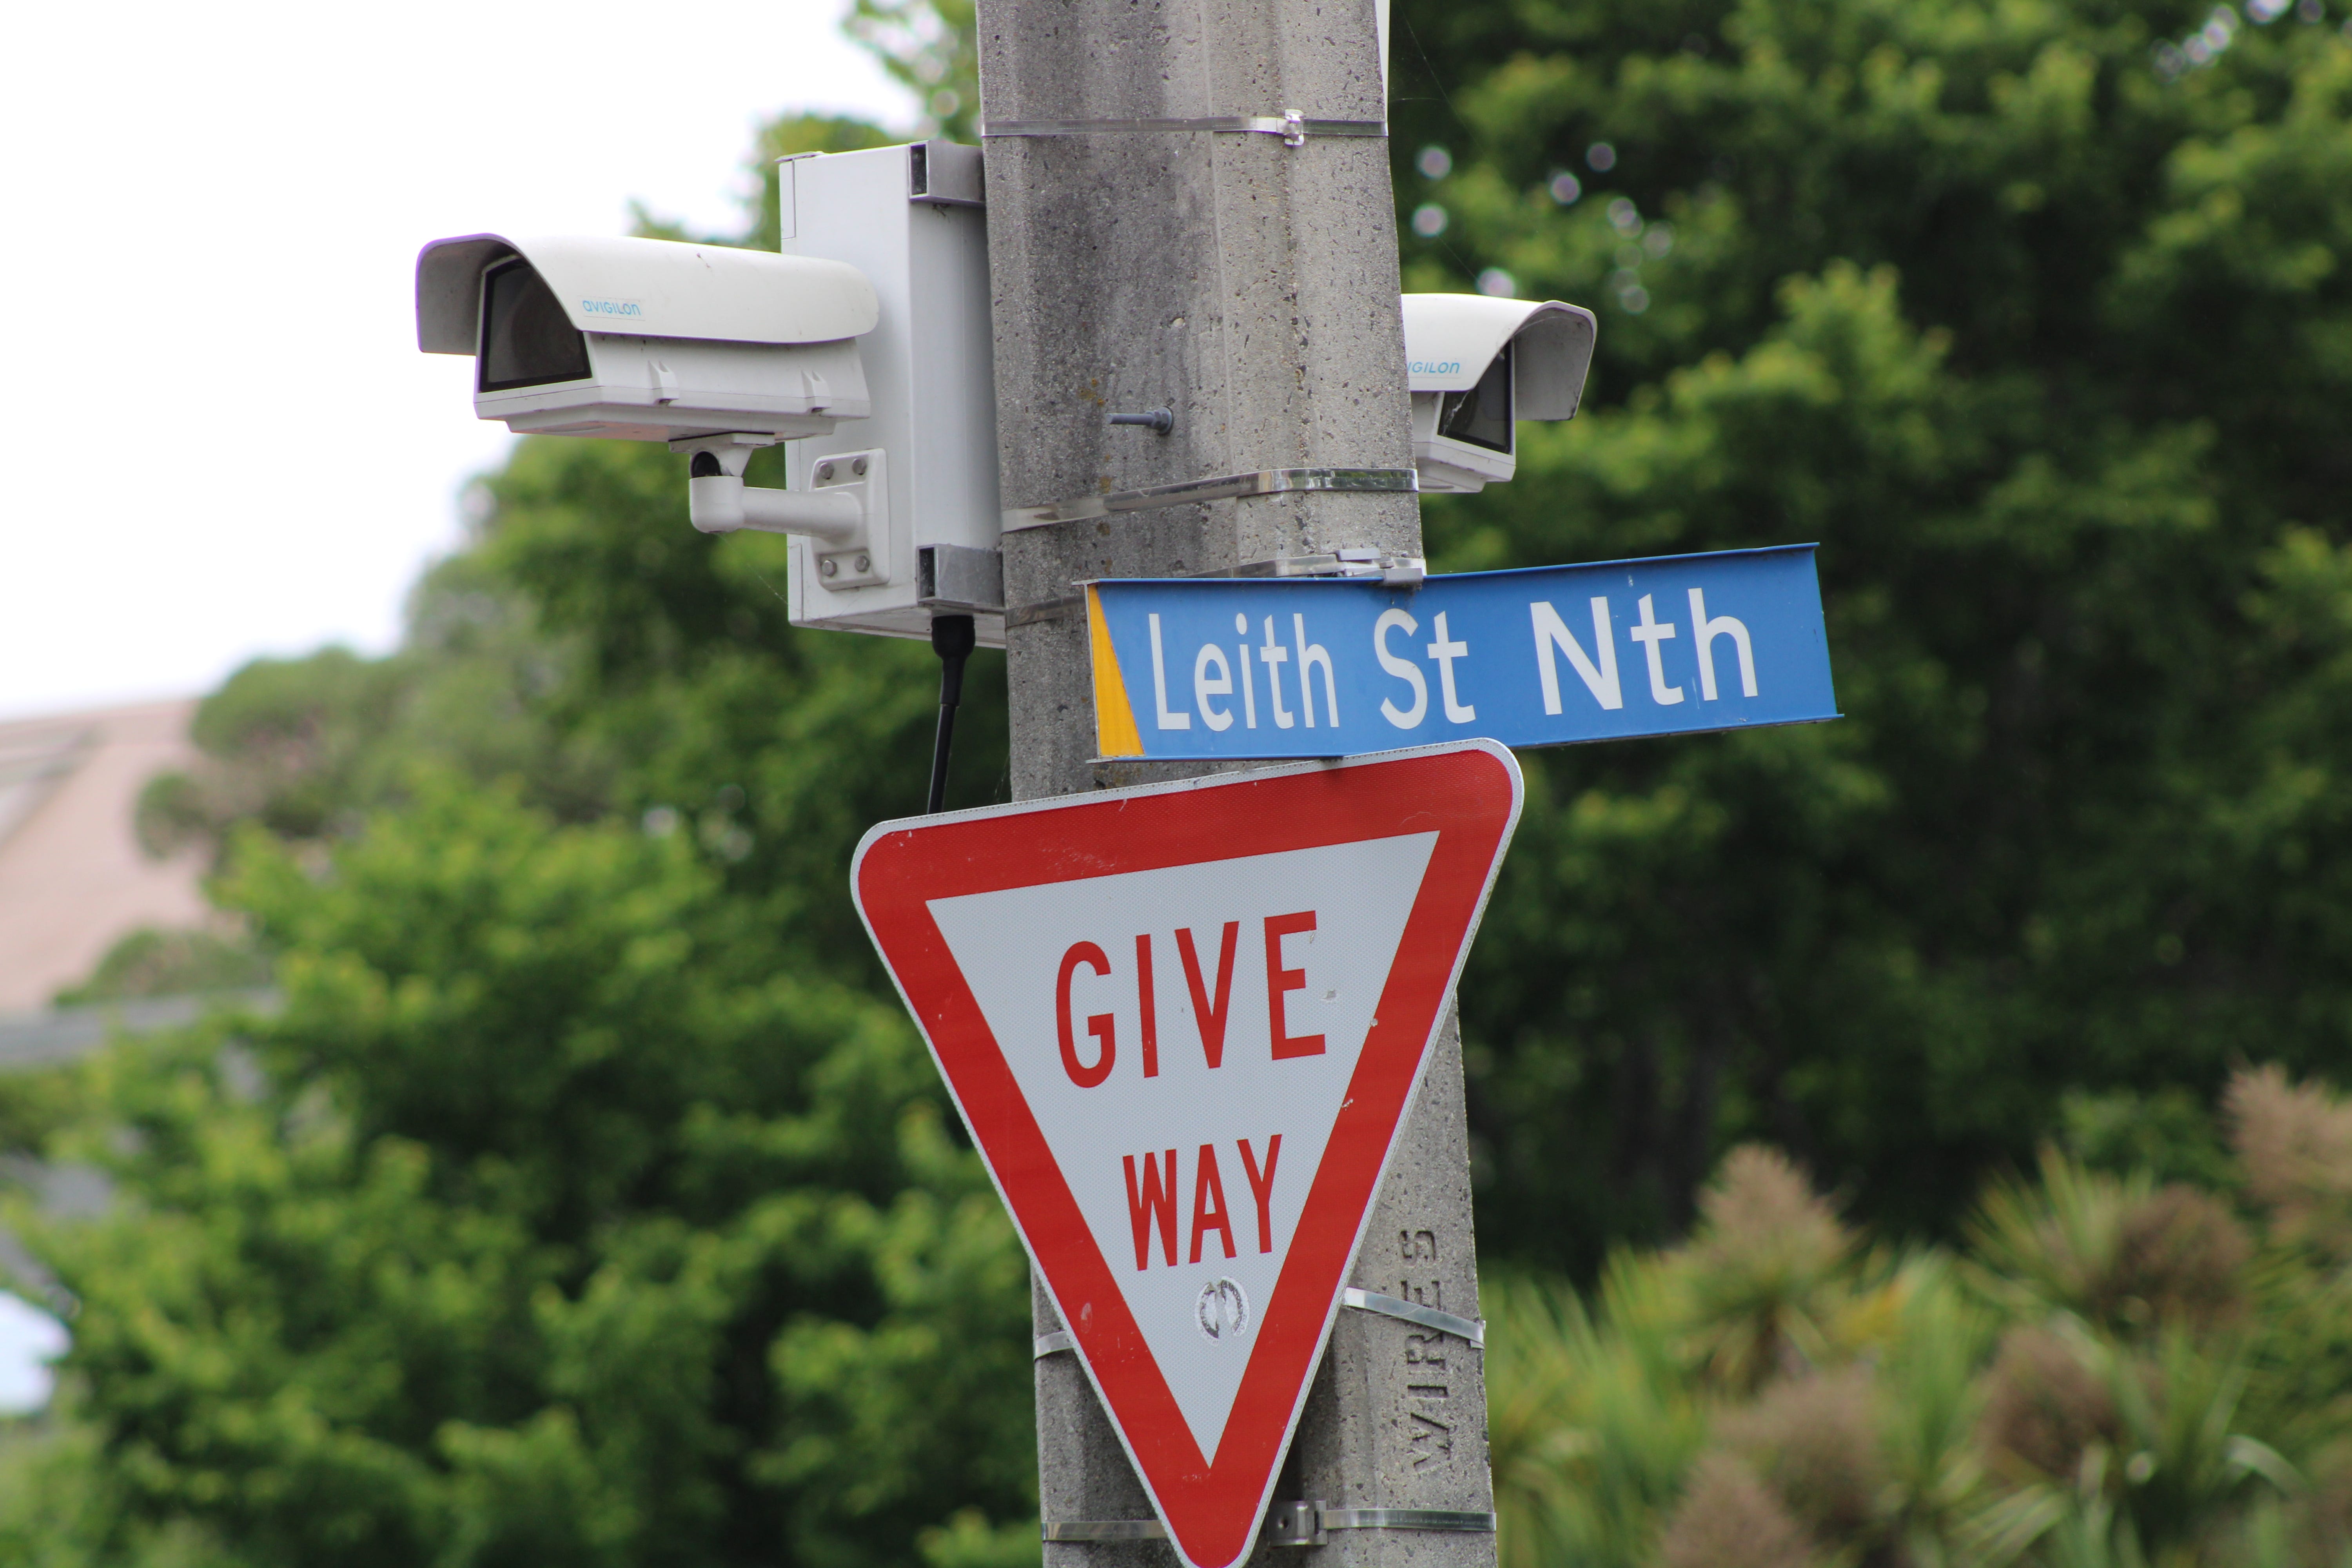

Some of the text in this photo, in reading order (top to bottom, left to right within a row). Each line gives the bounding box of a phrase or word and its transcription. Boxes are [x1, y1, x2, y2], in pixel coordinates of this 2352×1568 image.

[1149, 588, 1758, 732] Leith St Nth
[1056, 910, 1325, 1088] GIVE
[1123, 1134, 1282, 1270] WAY
[1399, 1229, 1451, 1475] WIRES
